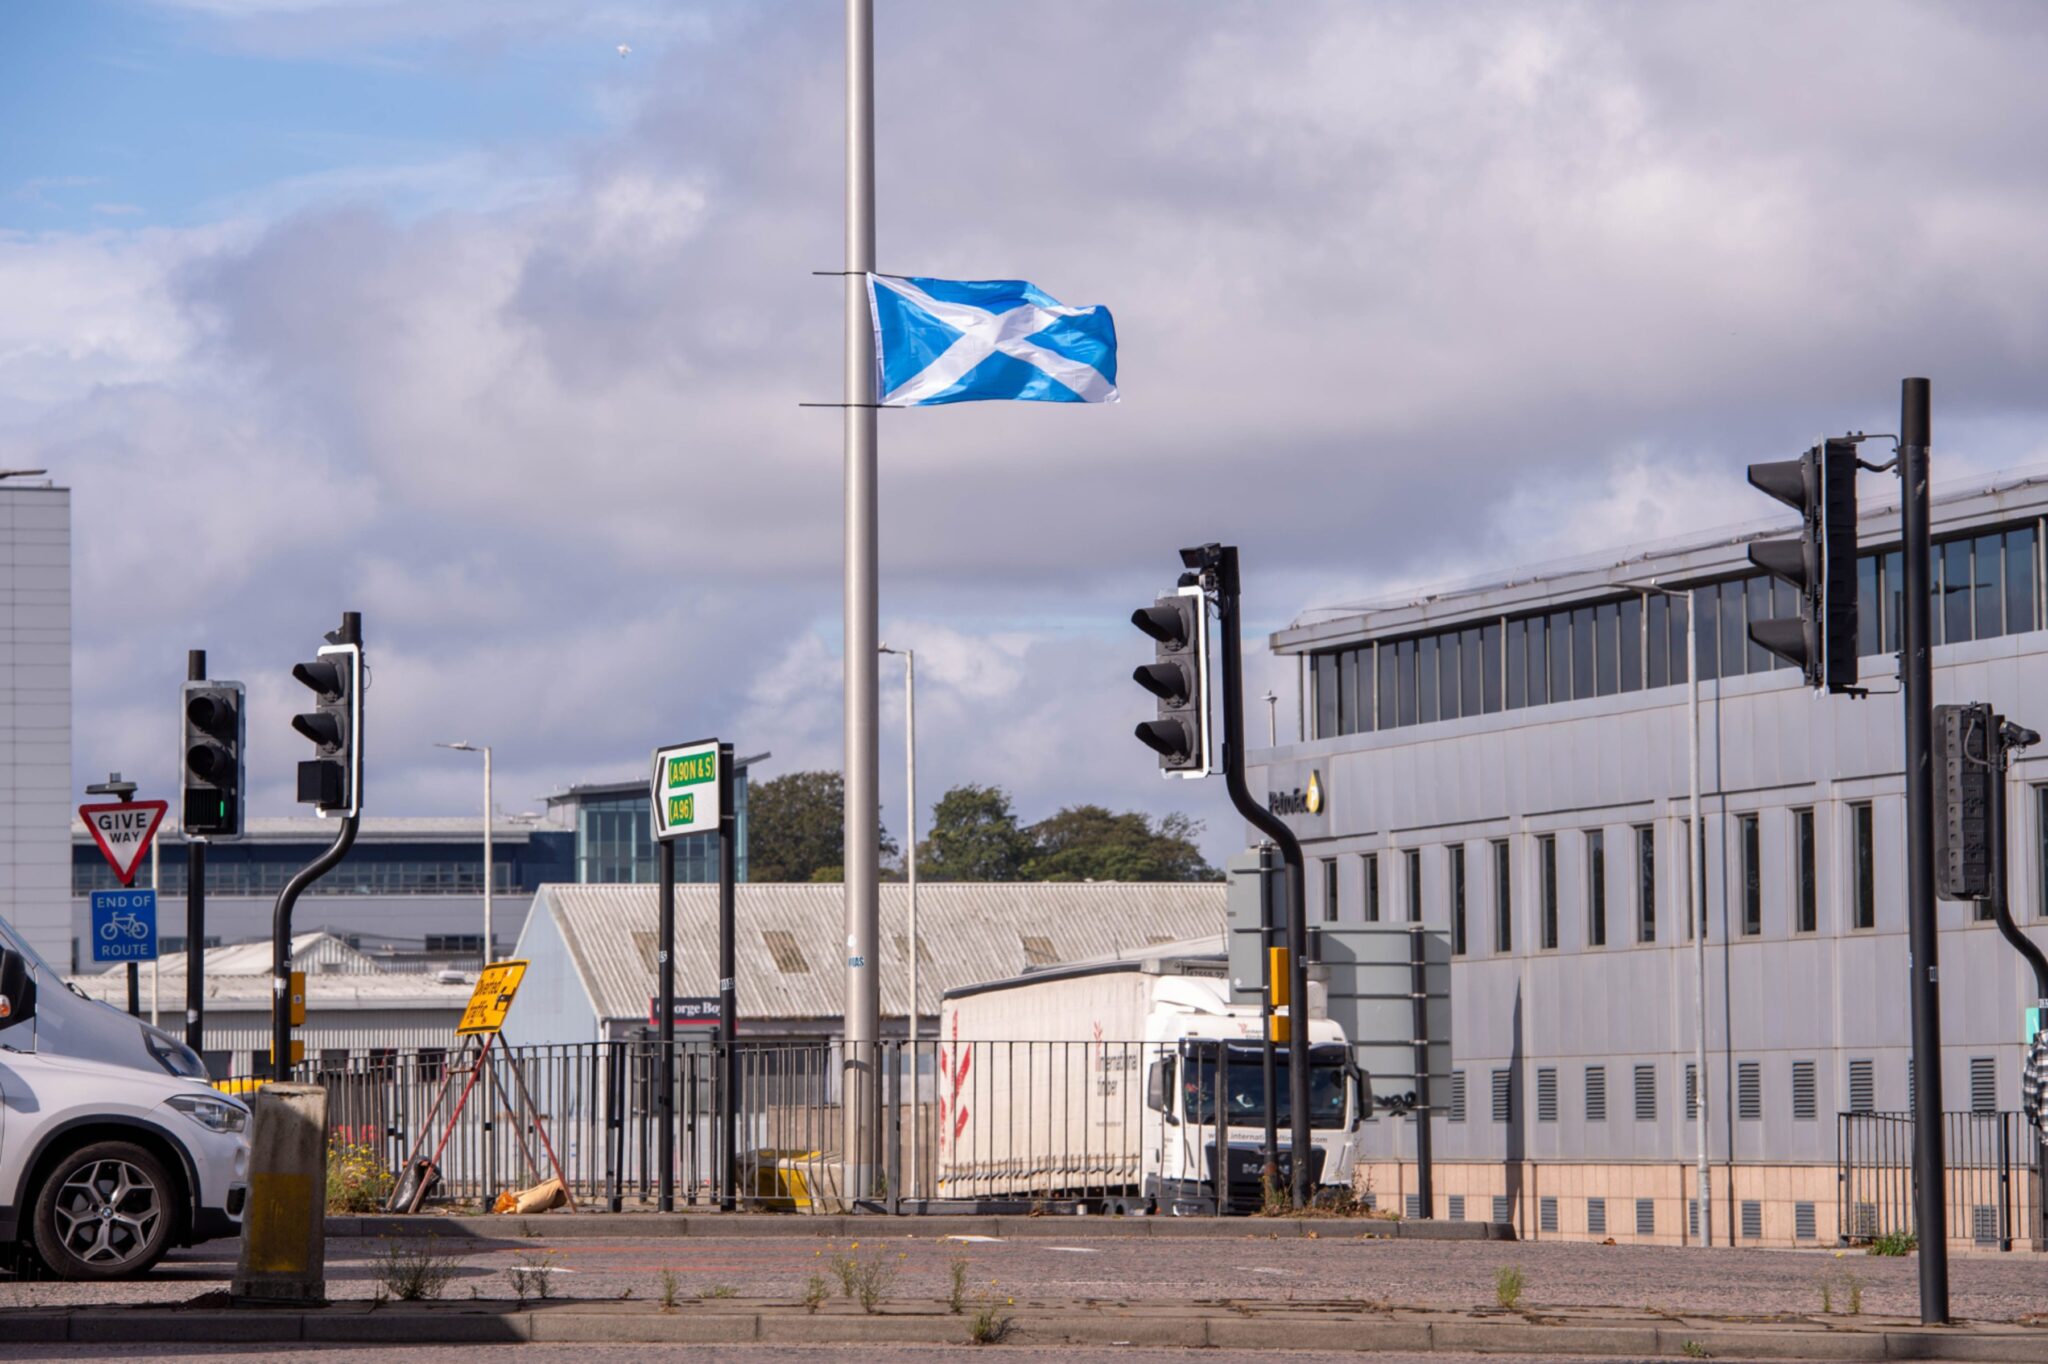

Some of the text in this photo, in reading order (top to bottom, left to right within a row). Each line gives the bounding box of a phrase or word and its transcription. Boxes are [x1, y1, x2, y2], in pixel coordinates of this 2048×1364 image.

[669, 796, 693, 824] (A96)
[98, 813, 147, 830] GIVE
[110, 831, 140, 843] WAY
[97, 895, 151, 908] END OF
[102, 944, 149, 956] ROUTE
[656, 1003, 701, 1016] orge
